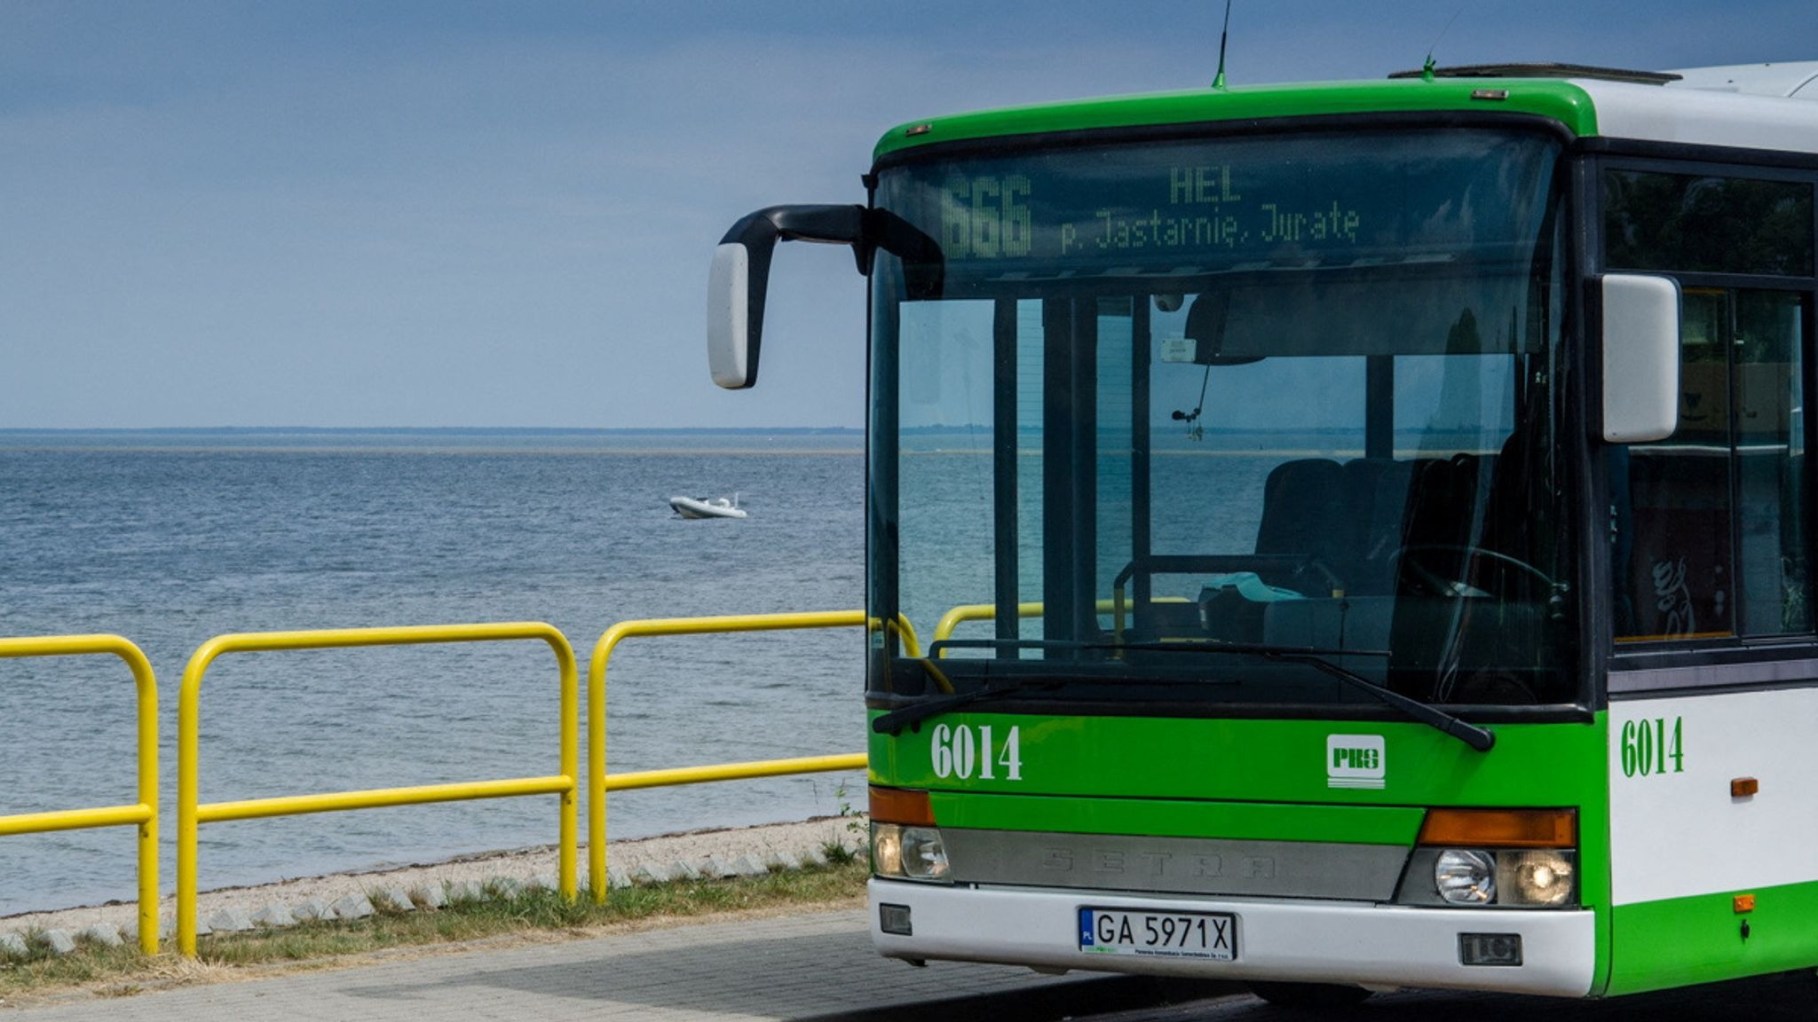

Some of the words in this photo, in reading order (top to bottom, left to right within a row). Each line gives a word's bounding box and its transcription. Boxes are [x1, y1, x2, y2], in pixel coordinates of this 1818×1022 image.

[1170, 165, 1241, 203] HEL
[941, 174, 1031, 260] 666
[1061, 222, 1083, 254] p.
[1096, 207, 1248, 248] Jastarnię,
[1261, 200, 1359, 243] Juratę
[931, 723, 1023, 780] 6014
[1620, 716, 1684, 778] 6014
[1044, 848, 1276, 880] SETRA
[1098, 914, 1134, 944] GA
[1145, 916, 1228, 949] 5971X
